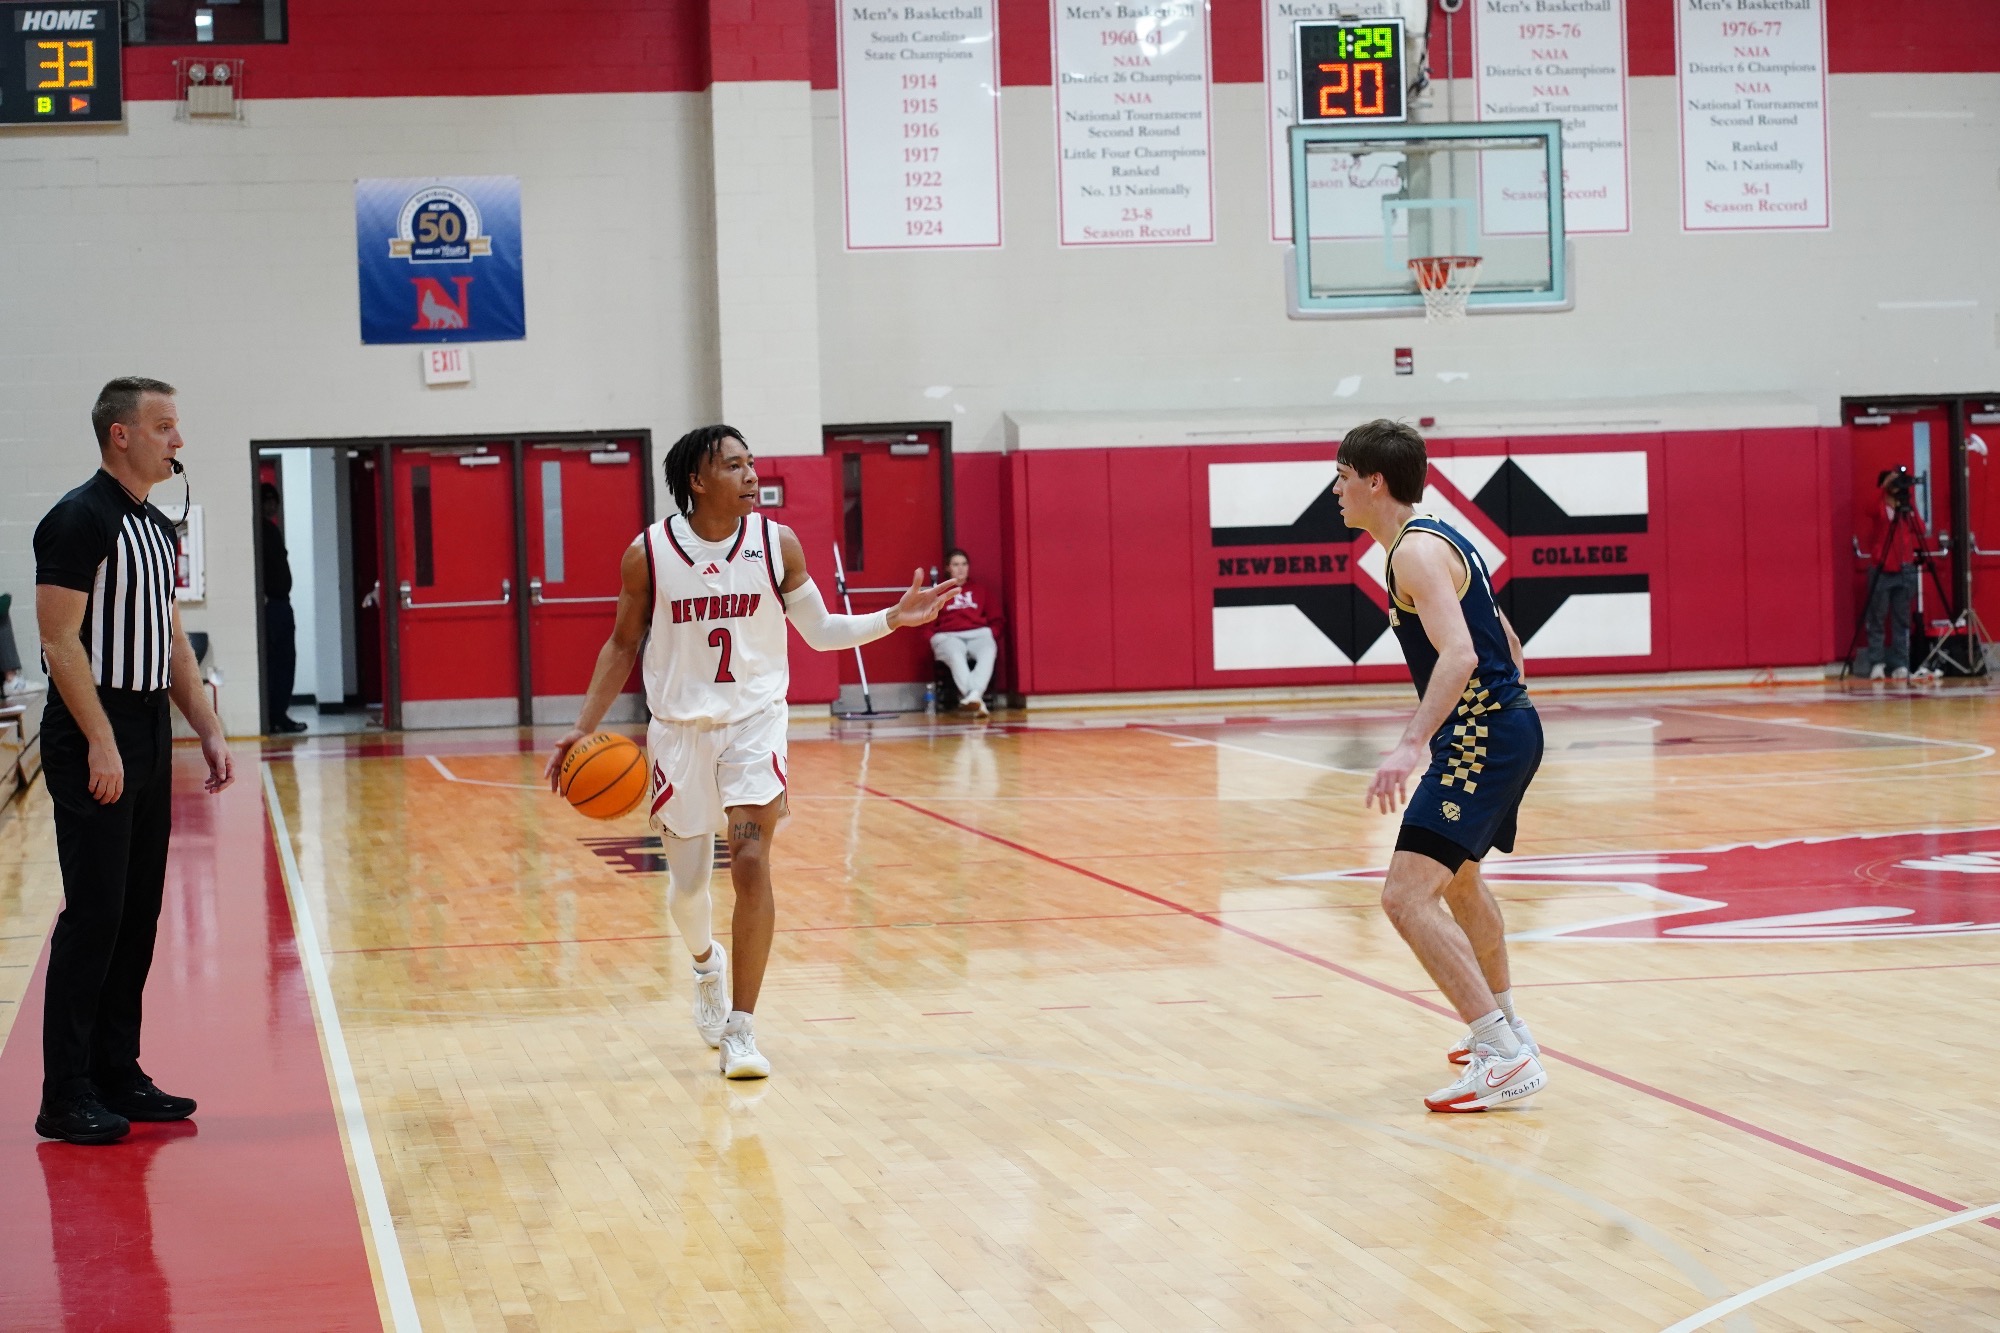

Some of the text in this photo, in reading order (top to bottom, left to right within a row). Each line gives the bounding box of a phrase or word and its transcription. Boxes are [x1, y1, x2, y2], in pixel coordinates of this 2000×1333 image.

[1067, 5, 1195, 20] Men's Basketll
[1279, 3, 1323, 17] Men's
[1486, 0, 1611, 13] Men's Basketball
[1688, 0, 1811, 11] Men's Basketball
[22, 9, 98, 31] HOME
[853, 6, 983, 21] Men's Basketball
[1519, 23, 1581, 39] 1975-76
[1721, 21, 1782, 37] 1976-77
[871, 31, 966, 43] South Carolina
[1101, 30, 1163, 46] 1960-61
[1338, 27, 1392, 59] 1:29
[865, 48, 974, 63] State Champions
[1531, 49, 1568, 60] NAIA
[1734, 46, 1770, 57] NAIA
[37, 40, 94, 88] 33
[1113, 56, 1152, 67] NAIA
[1689, 63, 1734, 74] District
[1748, 61, 1816, 76] Champions
[1062, 72, 1109, 84] District
[1130, 71, 1202, 85] Champions
[1486, 65, 1532, 77] District
[1546, 64, 1616, 78] Champions
[901, 74, 937, 89] 1914
[1735, 83, 1771, 94] NAIA
[1318, 62, 1384, 116] 20
[1533, 85, 1569, 96] NAIA
[37, 97, 52, 113] B
[1114, 93, 1152, 104] NAIA
[1689, 99, 1818, 111] National Tournament
[902, 98, 939, 114] 1915
[1485, 102, 1618, 114] National Tournament
[1066, 109, 1202, 122] National Tournament
[1710, 114, 1798, 126] Second Round
[903, 123, 939, 138] 1916
[1088, 125, 1180, 138] Second Round
[1561, 138, 1622, 152] hampions
[1732, 141, 1778, 152] Ranked
[904, 147, 940, 162] 1917
[1064, 146, 1206, 161] Little Four Champions
[1112, 165, 1160, 177] Ranked
[1706, 160, 1728, 171] No.
[1742, 159, 1804, 173] Nationally
[905, 171, 942, 187] 1922
[1310, 179, 1343, 189] ason
[1081, 184, 1191, 198] No. 13 Nationally
[1563, 186, 1607, 199] ecord
[1742, 182, 1770, 195] 36-1
[906, 196, 943, 211] 1923
[1704, 198, 1808, 213] Season Record
[1121, 207, 1153, 221] 23-8
[419, 212, 461, 243] 50
[906, 220, 943, 236] 1924
[1083, 225, 1191, 239] Season Record
[432, 349, 461, 373] EXIT
[744, 549, 763, 559] SAC
[1532, 545, 1628, 565] COLLEGE
[1218, 554, 1348, 576] NEWBERRY
[708, 627, 736, 683] 2
[1501, 1084, 1530, 1099] Micah
